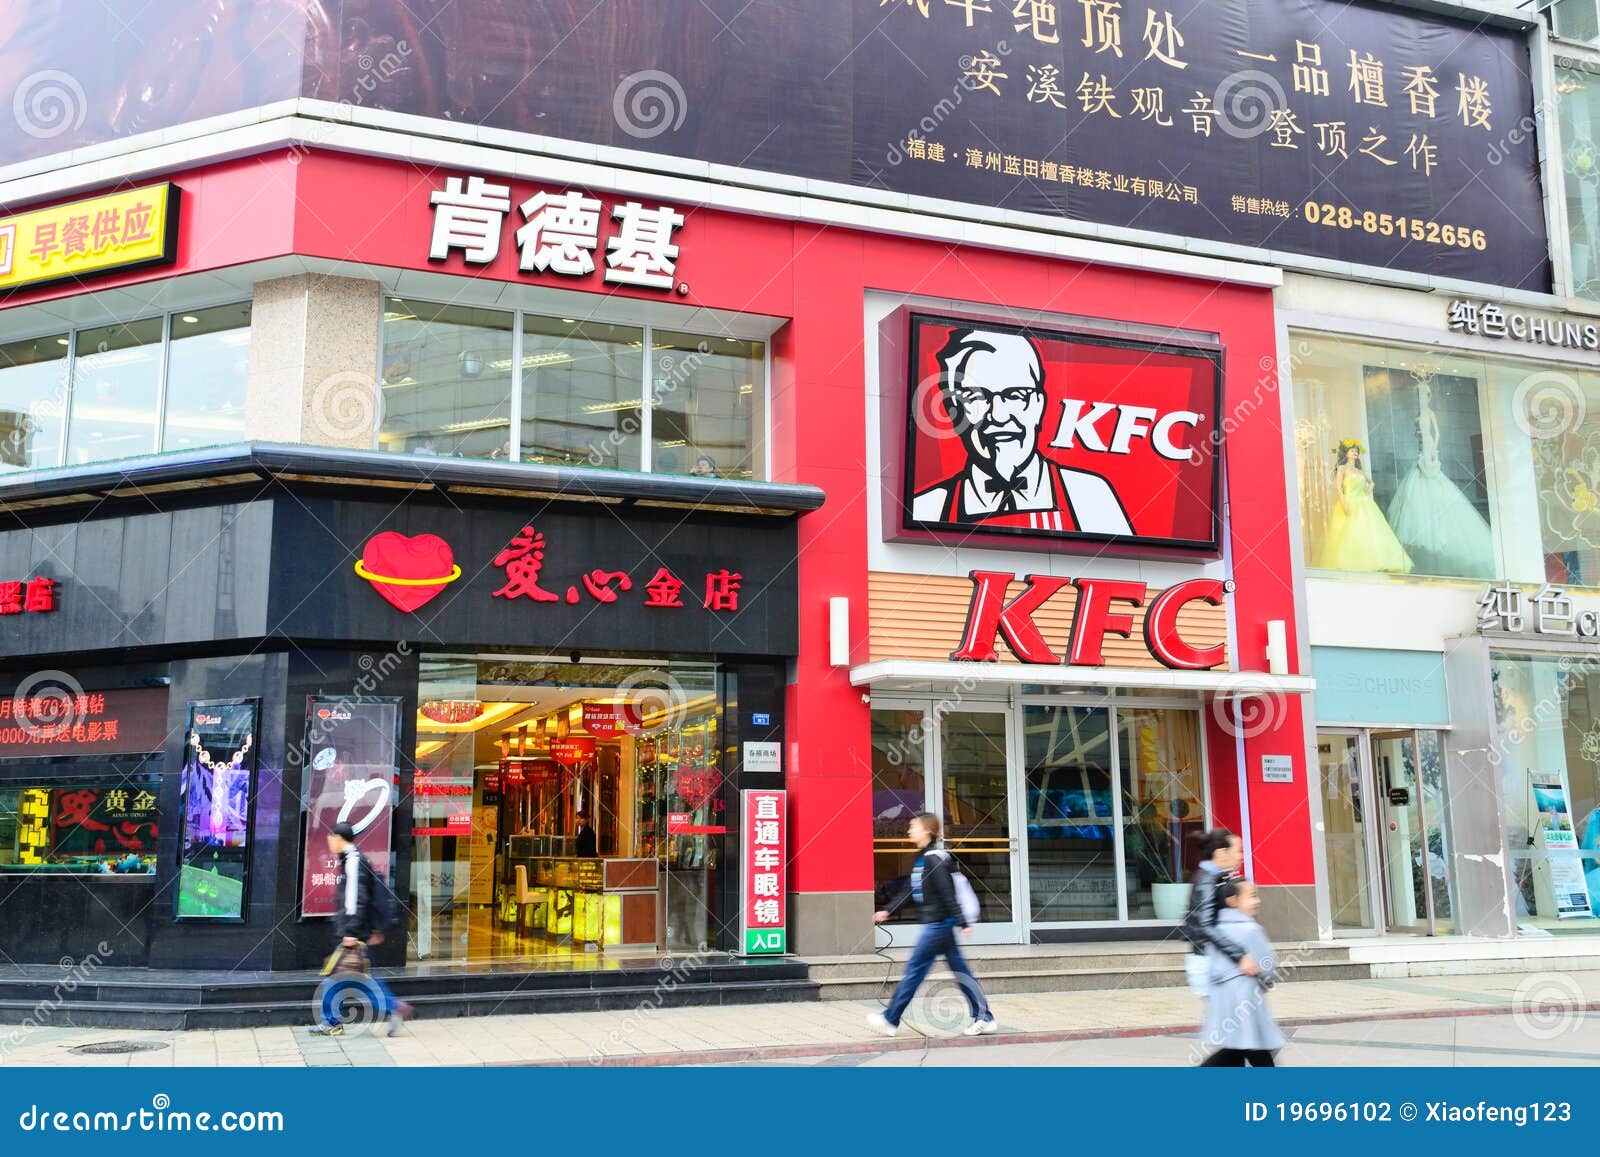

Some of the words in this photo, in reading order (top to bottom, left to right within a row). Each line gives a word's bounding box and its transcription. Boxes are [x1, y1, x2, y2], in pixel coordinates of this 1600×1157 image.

[963, 49, 1220, 138] 安溪铁观音
[1266, 108, 1440, 178] 登顶之作
[1236, 37, 1493, 132] 一品檀香楼
[30, 200, 154, 262] 早餐供应
[427, 175, 684, 292] 肯德基
[1303, 200, 1488, 252] 028-85152656
[1049, 398, 1200, 462] KFC
[950, 570, 1226, 670] KFC
[0, 720, 118, 744] 000元再送电影票
[105, 790, 157, 812] 黄金
[753, 795, 781, 926] 直通车眼镜
[752, 931, 782, 949] 入口
